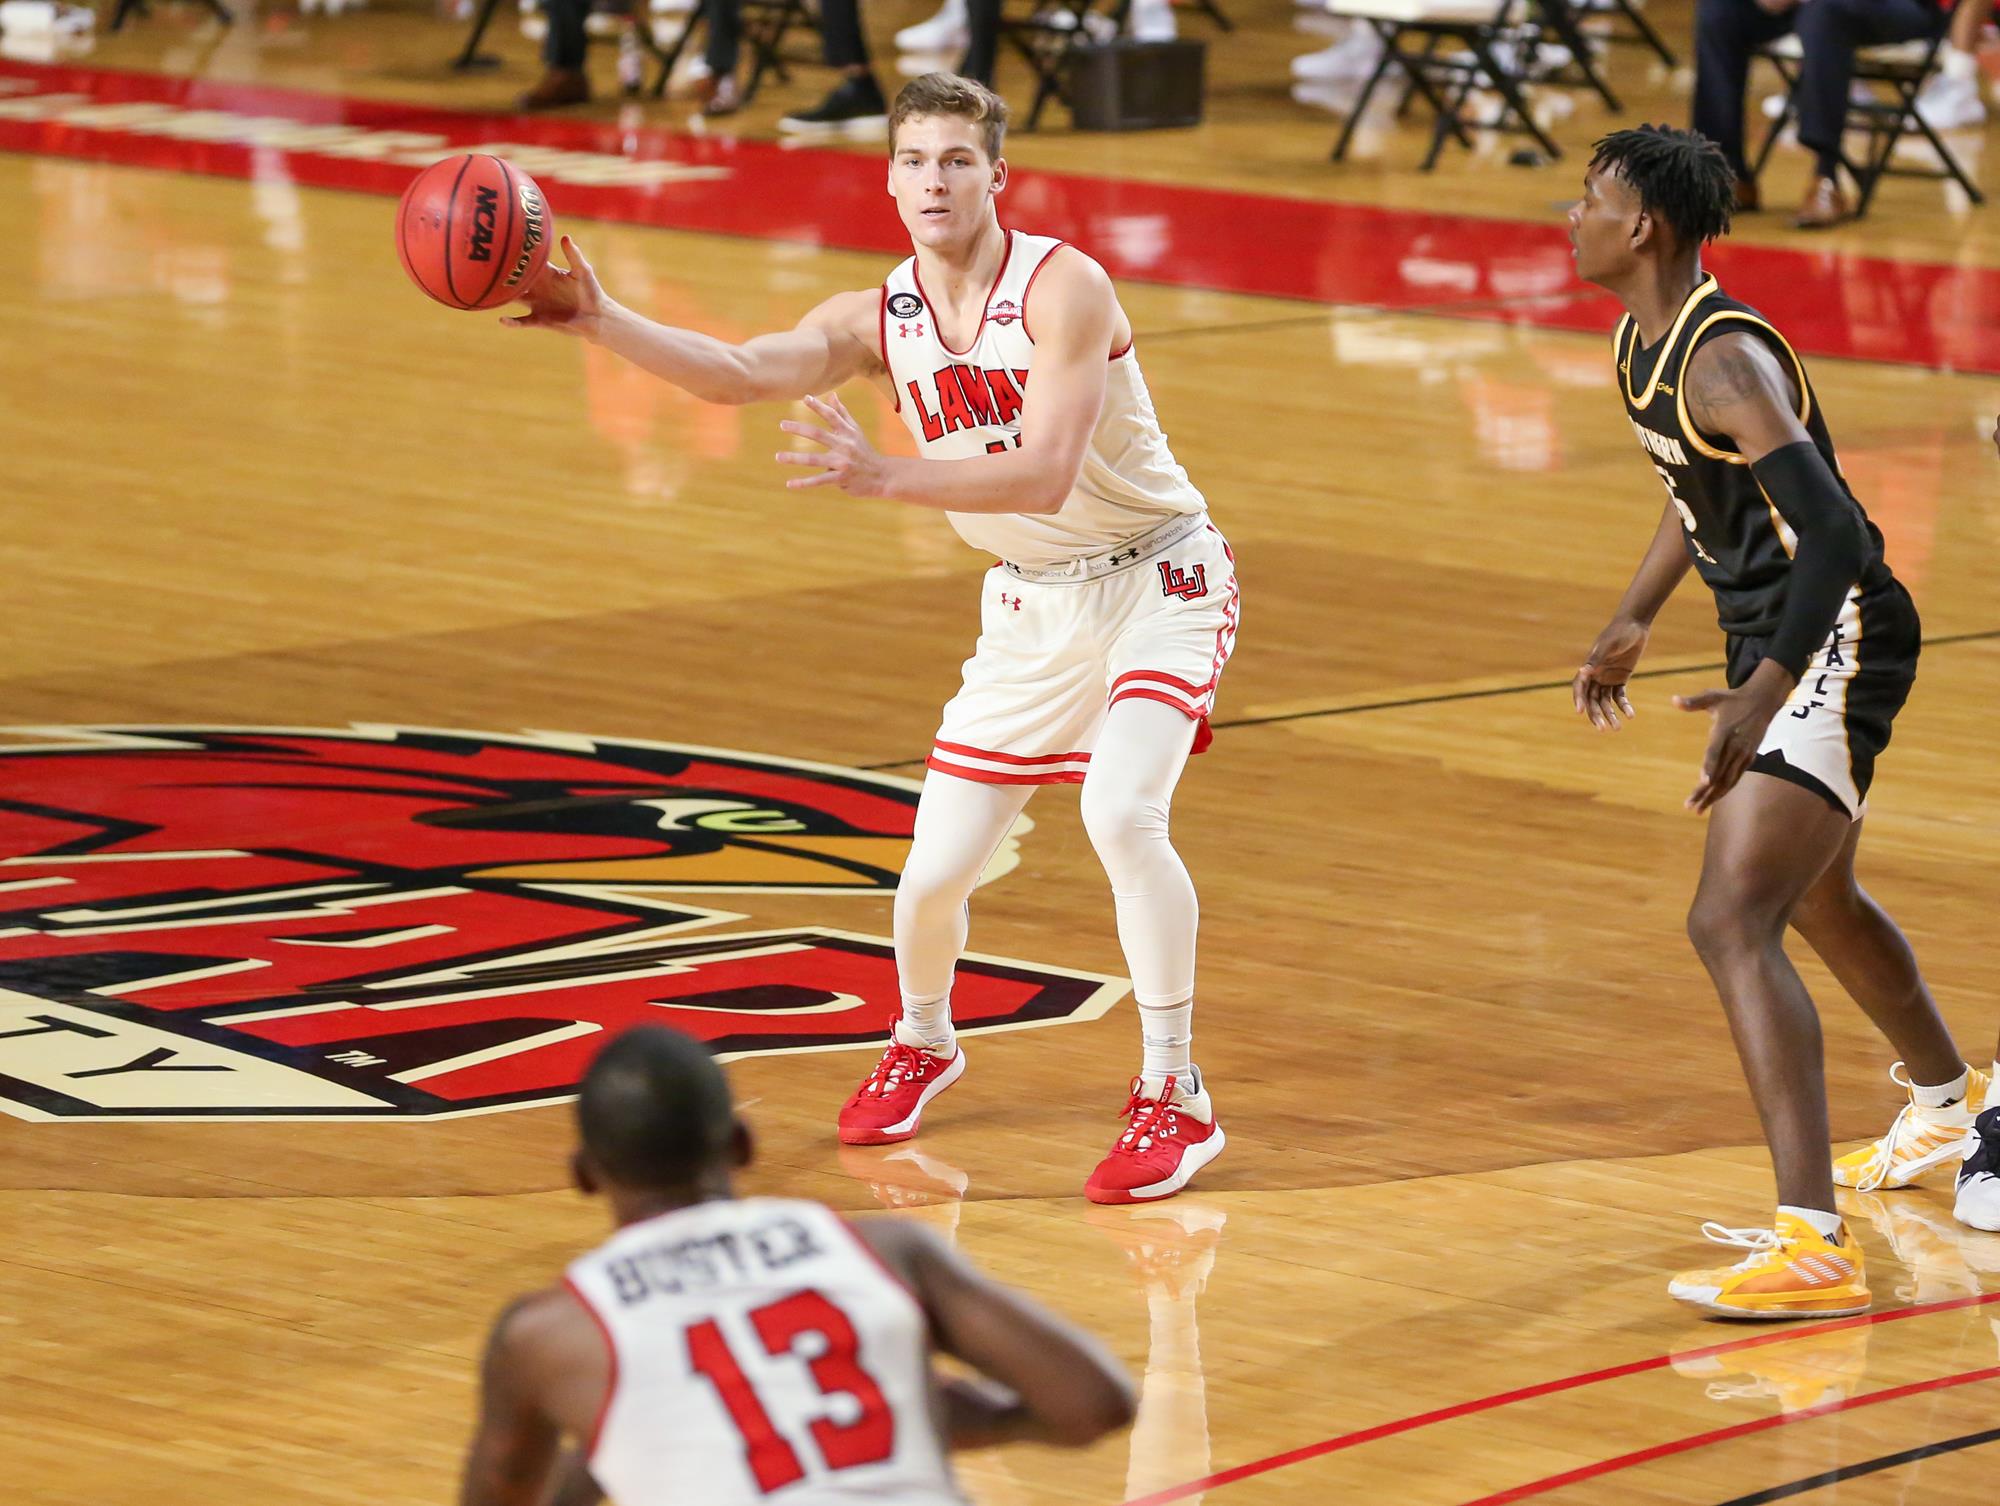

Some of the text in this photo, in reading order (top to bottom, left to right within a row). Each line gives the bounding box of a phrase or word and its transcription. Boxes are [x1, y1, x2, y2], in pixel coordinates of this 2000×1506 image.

[468, 184, 498, 262] NCAA
[503, 184, 544, 287] Wilson
[906, 364, 1030, 443] LAMA
[683, 1286, 896, 1495] 13
